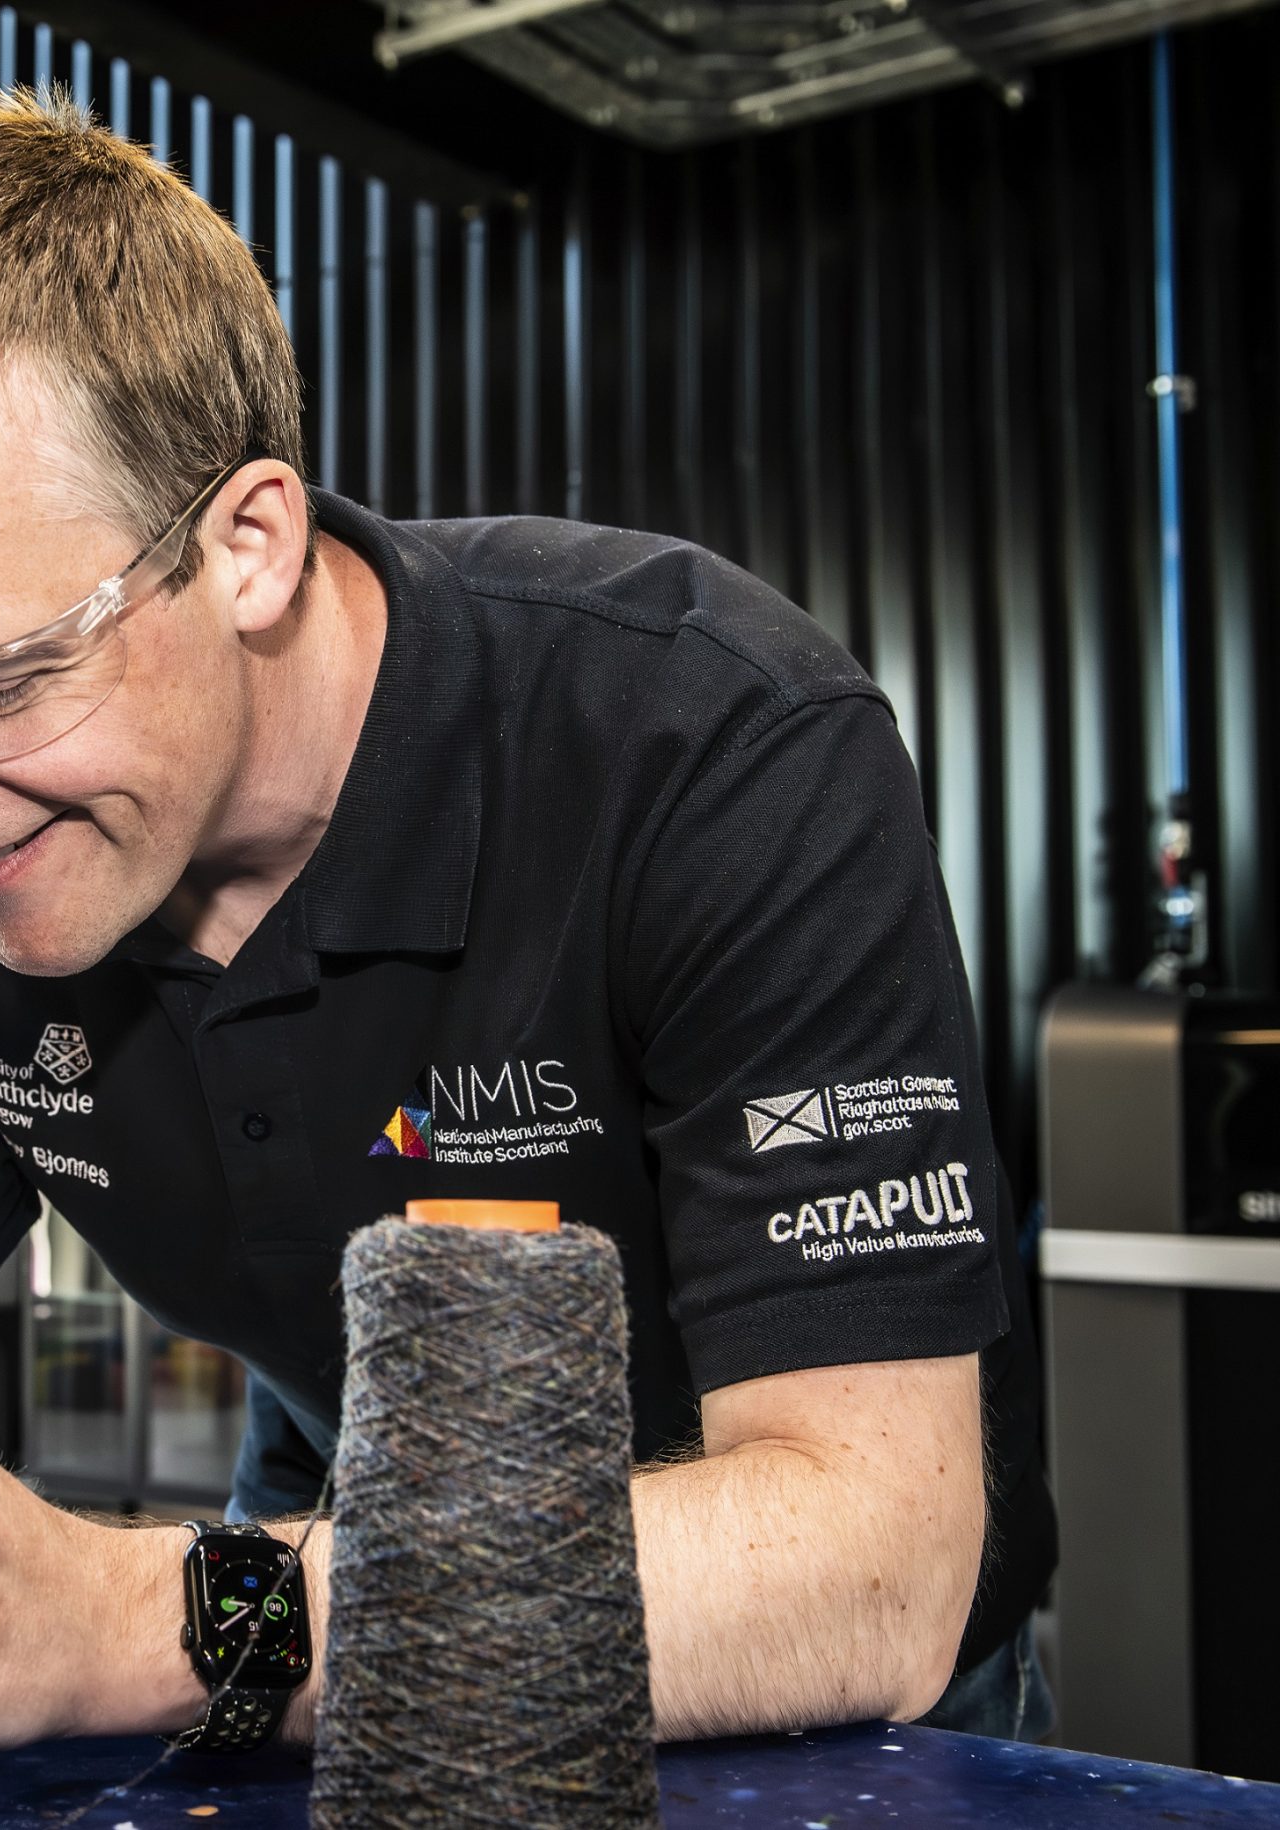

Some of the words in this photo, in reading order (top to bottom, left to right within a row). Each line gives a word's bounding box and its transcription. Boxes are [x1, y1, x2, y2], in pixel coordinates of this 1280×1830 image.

[19, 1063, 35, 1080] of
[430, 1059, 578, 1121] NMIS
[834, 1077, 898, 1101] Scottish
[838, 1096, 923, 1120] Riaghaltas
[433, 1127, 492, 1145] National
[492, 1116, 605, 1145] Manufacturing
[842, 1114, 913, 1141] gov.scot
[435, 1146, 494, 1164] Institute
[495, 1139, 570, 1163] Scotland
[32, 1146, 110, 1188] Bjonnes
[768, 1162, 973, 1243] CATAPULT
[802, 1239, 844, 1261] High
[845, 1236, 895, 1255] Value
